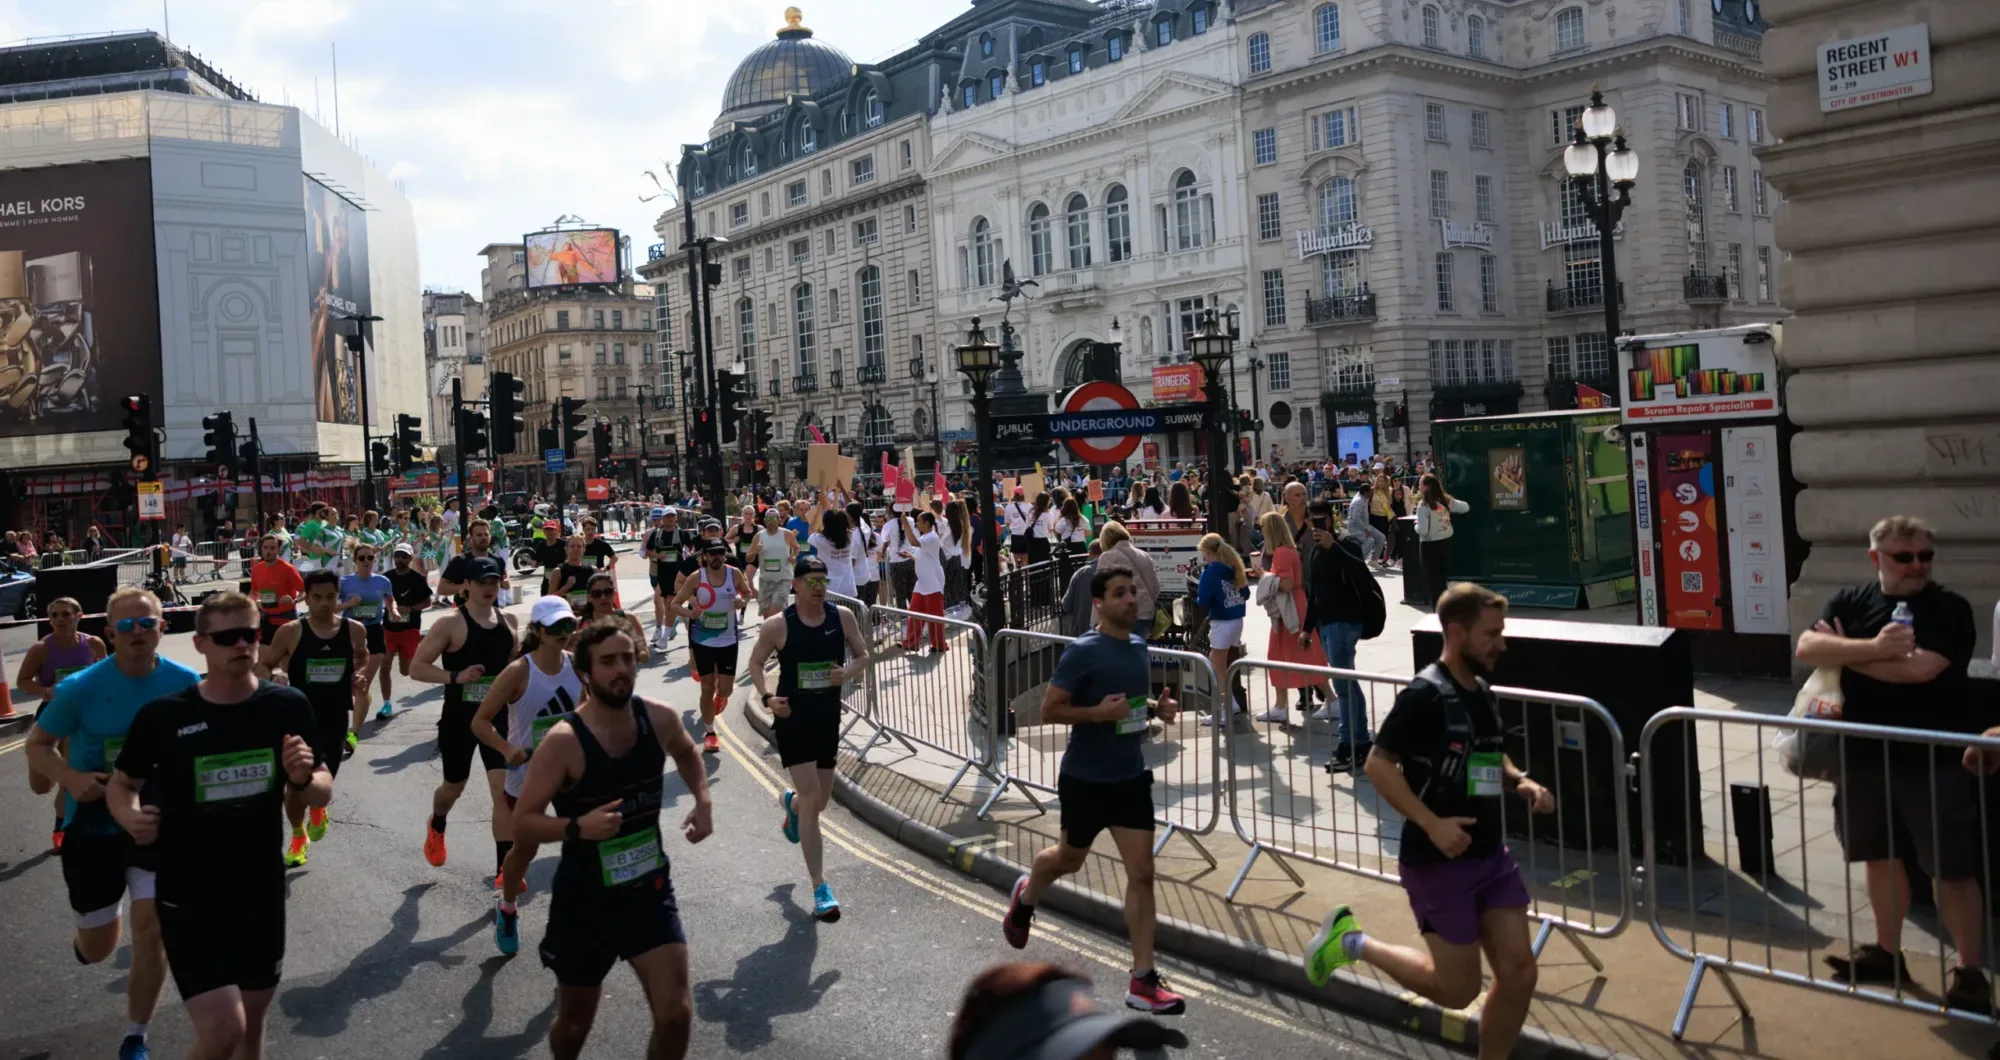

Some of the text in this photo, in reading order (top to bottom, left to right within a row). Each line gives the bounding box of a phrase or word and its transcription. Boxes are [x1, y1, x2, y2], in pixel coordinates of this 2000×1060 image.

[1826, 37, 1889, 64] REGENT
[1828, 50, 1918, 81] STREET W1
[1830, 86, 1913, 108] CITY OF WESTMINSTER
[41, 196, 85, 213] KORS
[28, 217, 48, 225] POUR
[1296, 223, 1374, 260] Lillywhites
[1644, 401, 1754, 416] Screen Repair Specialist
[997, 413, 1204, 434] PUBLIC UNDERGROUND SUBWAY
[1455, 421, 1559, 433] ICE CREAM
[144, 499, 157, 508] 148
[1637, 480, 1649, 528] SAMSUNG
[1155, 565, 1175, 573] Centre
[1644, 589, 1655, 625] oppo
[177, 722, 208, 737] HOKA
[217, 765, 268, 782] C 1433
[617, 854, 627, 865] B
